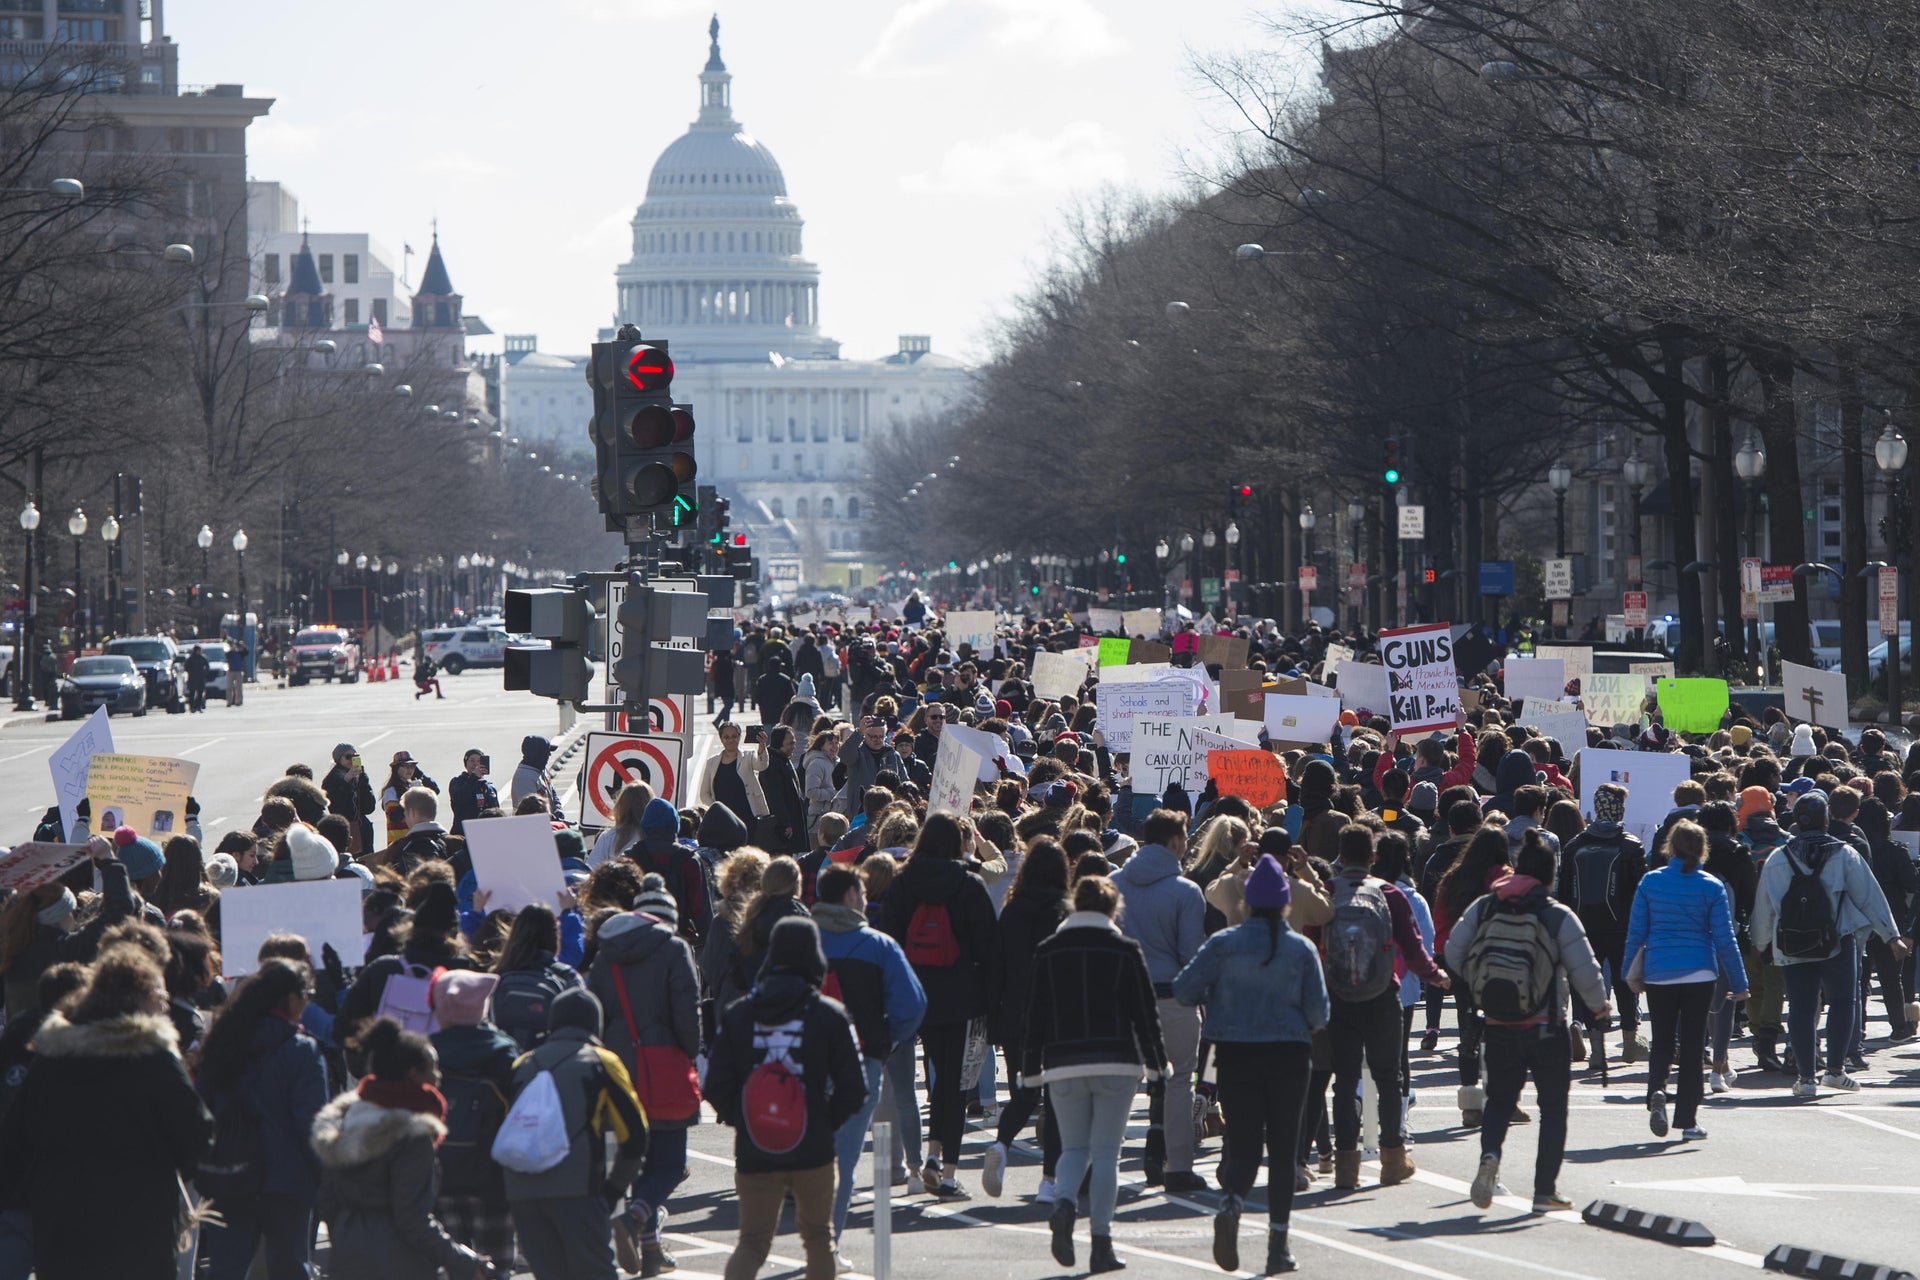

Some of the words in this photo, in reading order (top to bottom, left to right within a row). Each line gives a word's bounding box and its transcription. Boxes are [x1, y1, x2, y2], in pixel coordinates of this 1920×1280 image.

[949, 633, 993, 648] LIVES
[1384, 636, 1451, 669] GUNS
[1120, 696, 1148, 707] Schools
[1155, 696, 1170, 706] and
[1390, 695, 1422, 723] Kill
[1426, 695, 1458, 718] People
[1140, 722, 1171, 736] THE
[1145, 754, 1168, 766] CAN
[1171, 754, 1192, 766] SUC
